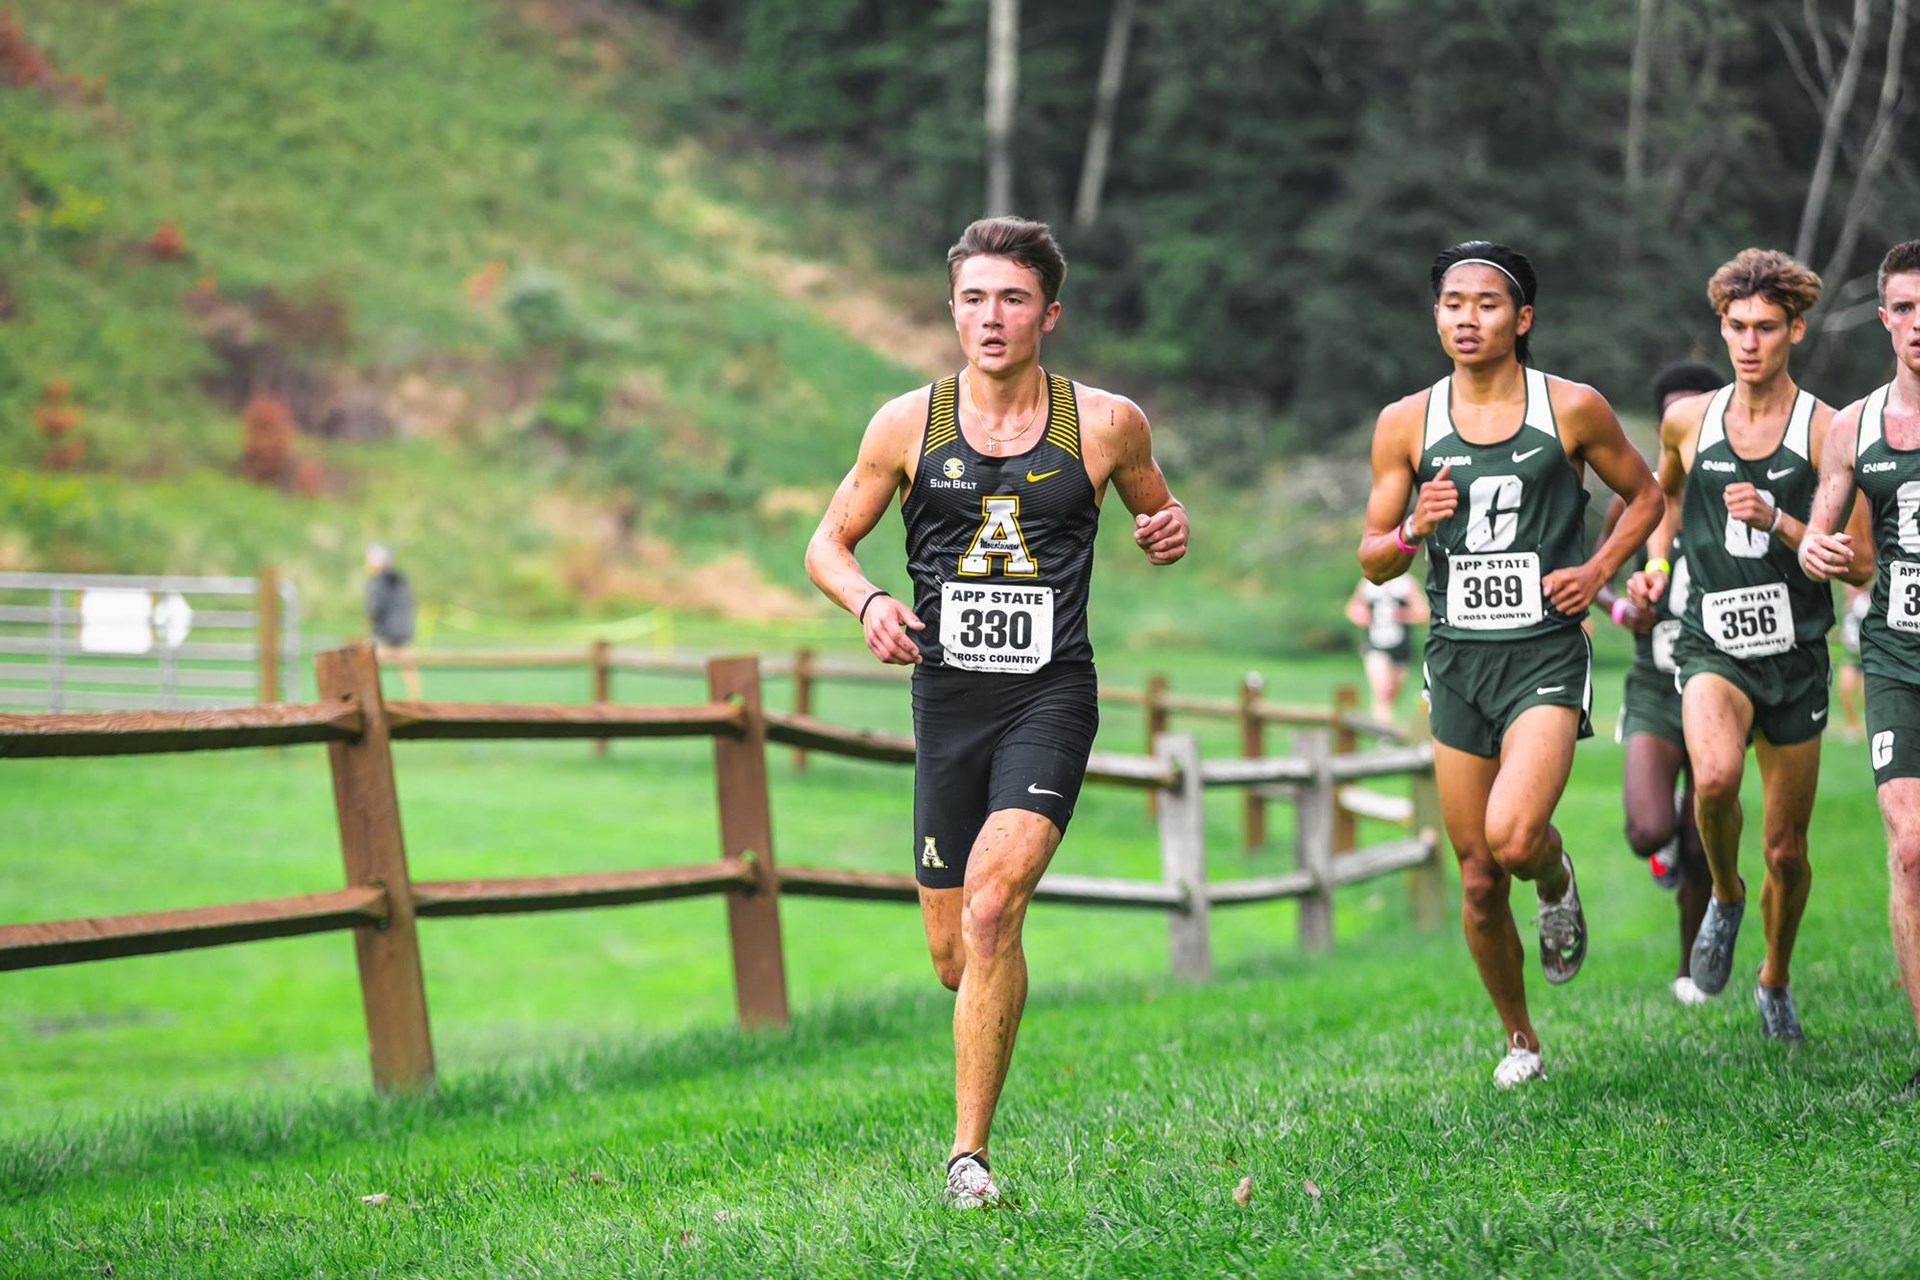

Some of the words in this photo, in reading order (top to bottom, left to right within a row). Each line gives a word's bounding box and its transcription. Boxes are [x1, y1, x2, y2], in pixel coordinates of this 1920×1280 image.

[957, 495, 1039, 578] A
[1456, 561, 1482, 572] APP
[1486, 559, 1531, 570] STATE
[950, 589, 986, 603] APP
[990, 591, 1044, 606] STATE
[1463, 574, 1523, 609] 369
[1740, 589, 1781, 603] STATE
[1457, 613, 1488, 622] CROSS
[1490, 612, 1532, 621] COUNTRY
[1720, 605, 1778, 640] 356
[960, 608, 1033, 650] 330
[989, 654, 1041, 665] COUNTRY
